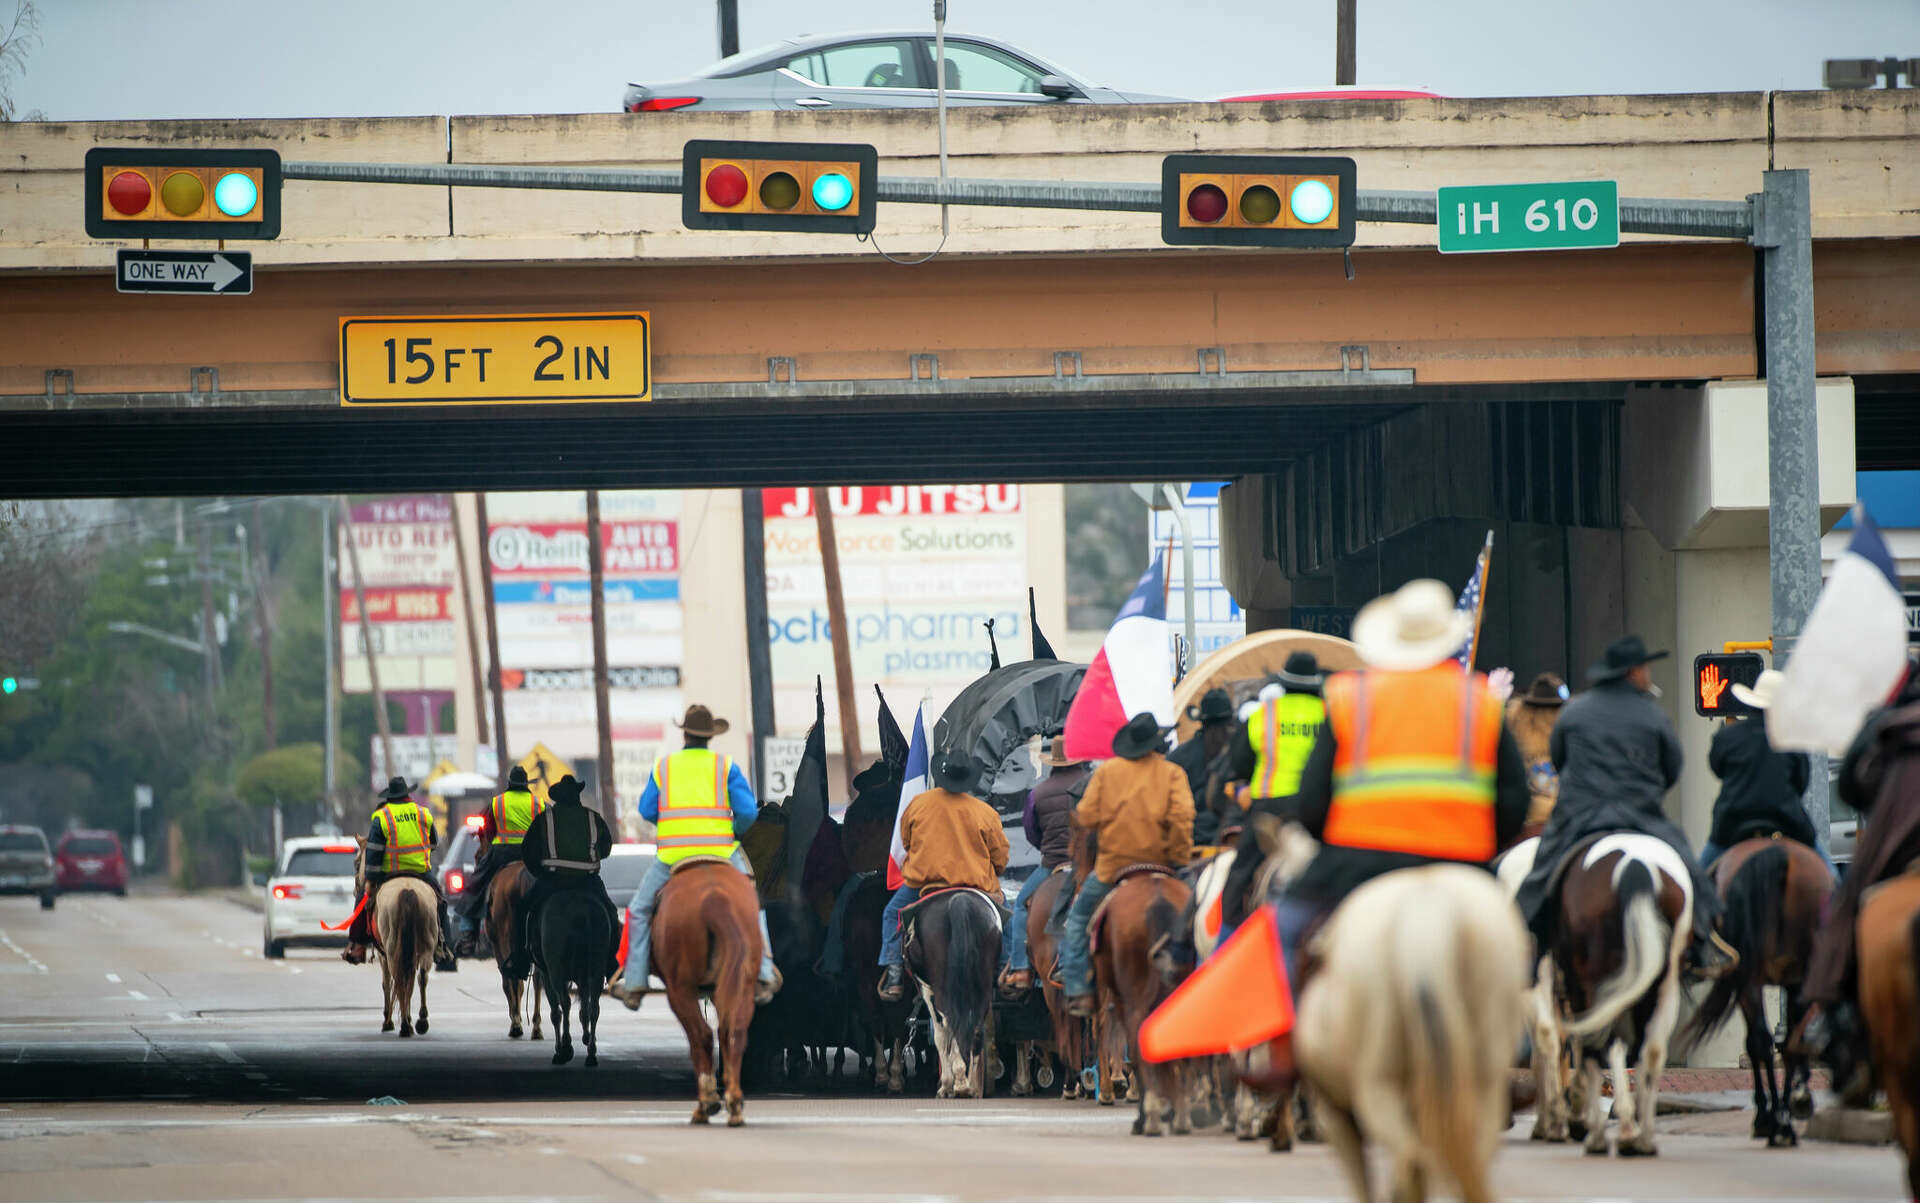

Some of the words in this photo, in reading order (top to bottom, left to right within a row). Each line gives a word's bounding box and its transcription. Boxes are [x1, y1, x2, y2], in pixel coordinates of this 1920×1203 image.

[1457, 201, 1499, 235] IH
[1524, 198, 1598, 232] 610
[129, 263, 166, 280] ONE
[172, 262, 209, 280] WAY
[781, 486, 862, 517] JU
[873, 485, 1019, 515] JITSU
[611, 525, 668, 546] AUTO
[900, 528, 1013, 551] Solutions
[605, 547, 675, 568] PARTS
[769, 744, 801, 756] SPEE
[771, 771, 797, 793] 3
